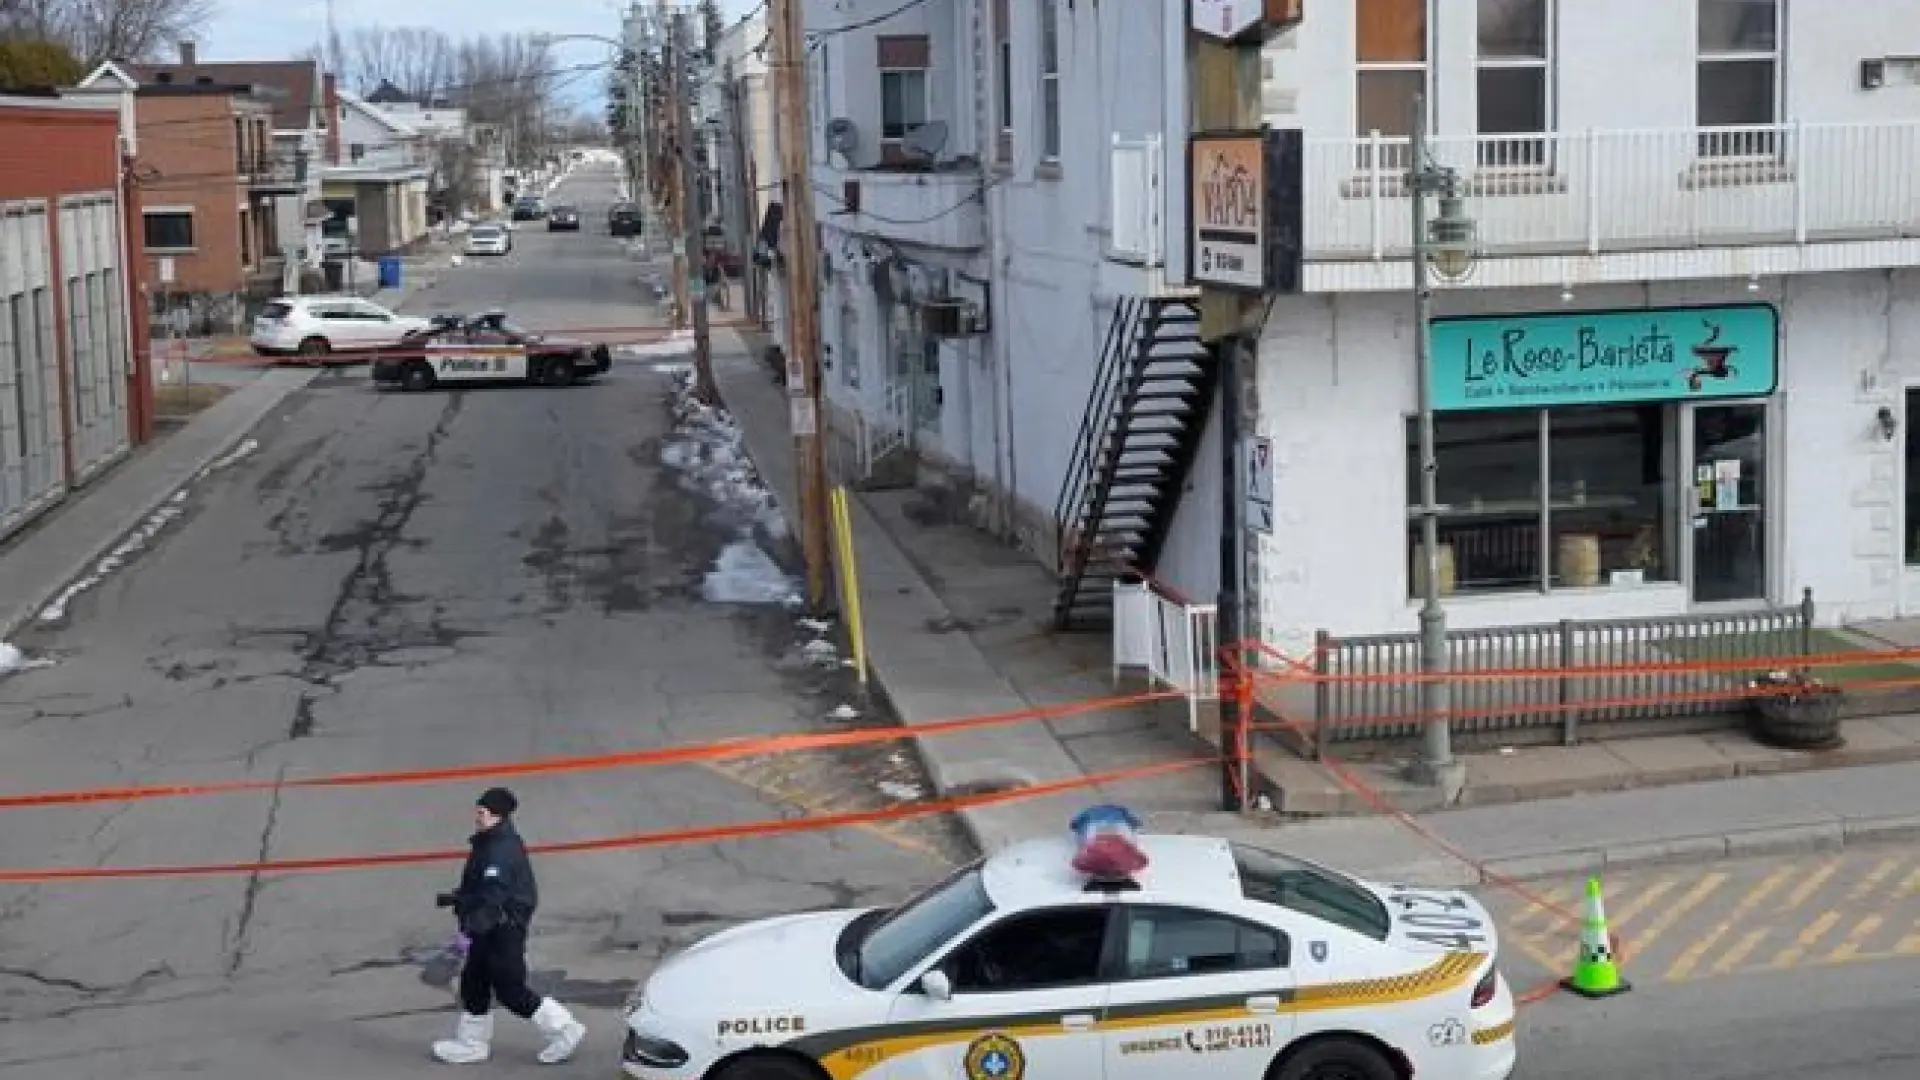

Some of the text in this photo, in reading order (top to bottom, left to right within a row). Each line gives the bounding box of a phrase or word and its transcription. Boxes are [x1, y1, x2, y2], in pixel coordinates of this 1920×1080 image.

[440, 356, 487, 371] Police
[1465, 336, 1498, 381] Le
[717, 1015, 804, 1036] POLICE
